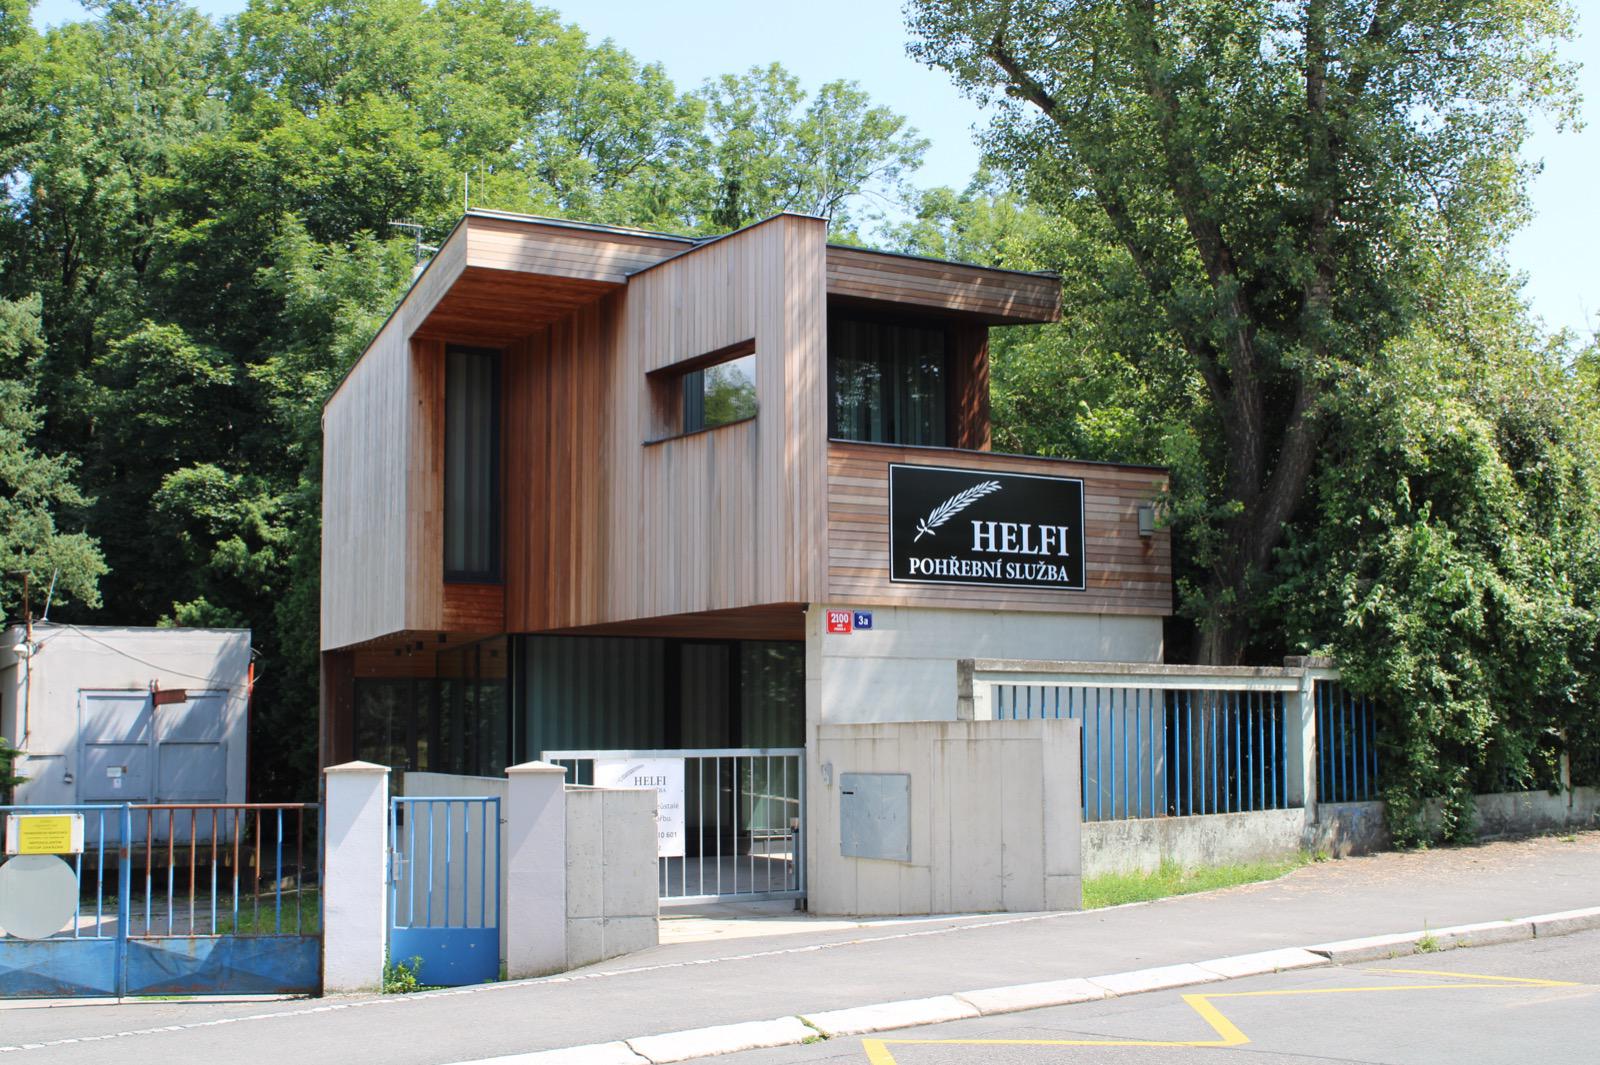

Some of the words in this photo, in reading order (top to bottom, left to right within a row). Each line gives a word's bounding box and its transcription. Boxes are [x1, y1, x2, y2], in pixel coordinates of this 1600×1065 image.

[971, 520, 1070, 556] HELFI
[909, 555, 1003, 579] POHŘEBNÍ
[1006, 561, 1070, 582] SLUŽBA
[831, 613, 849, 623] 2100
[858, 615, 869, 625] 3a
[634, 775, 667, 786] HELFI
